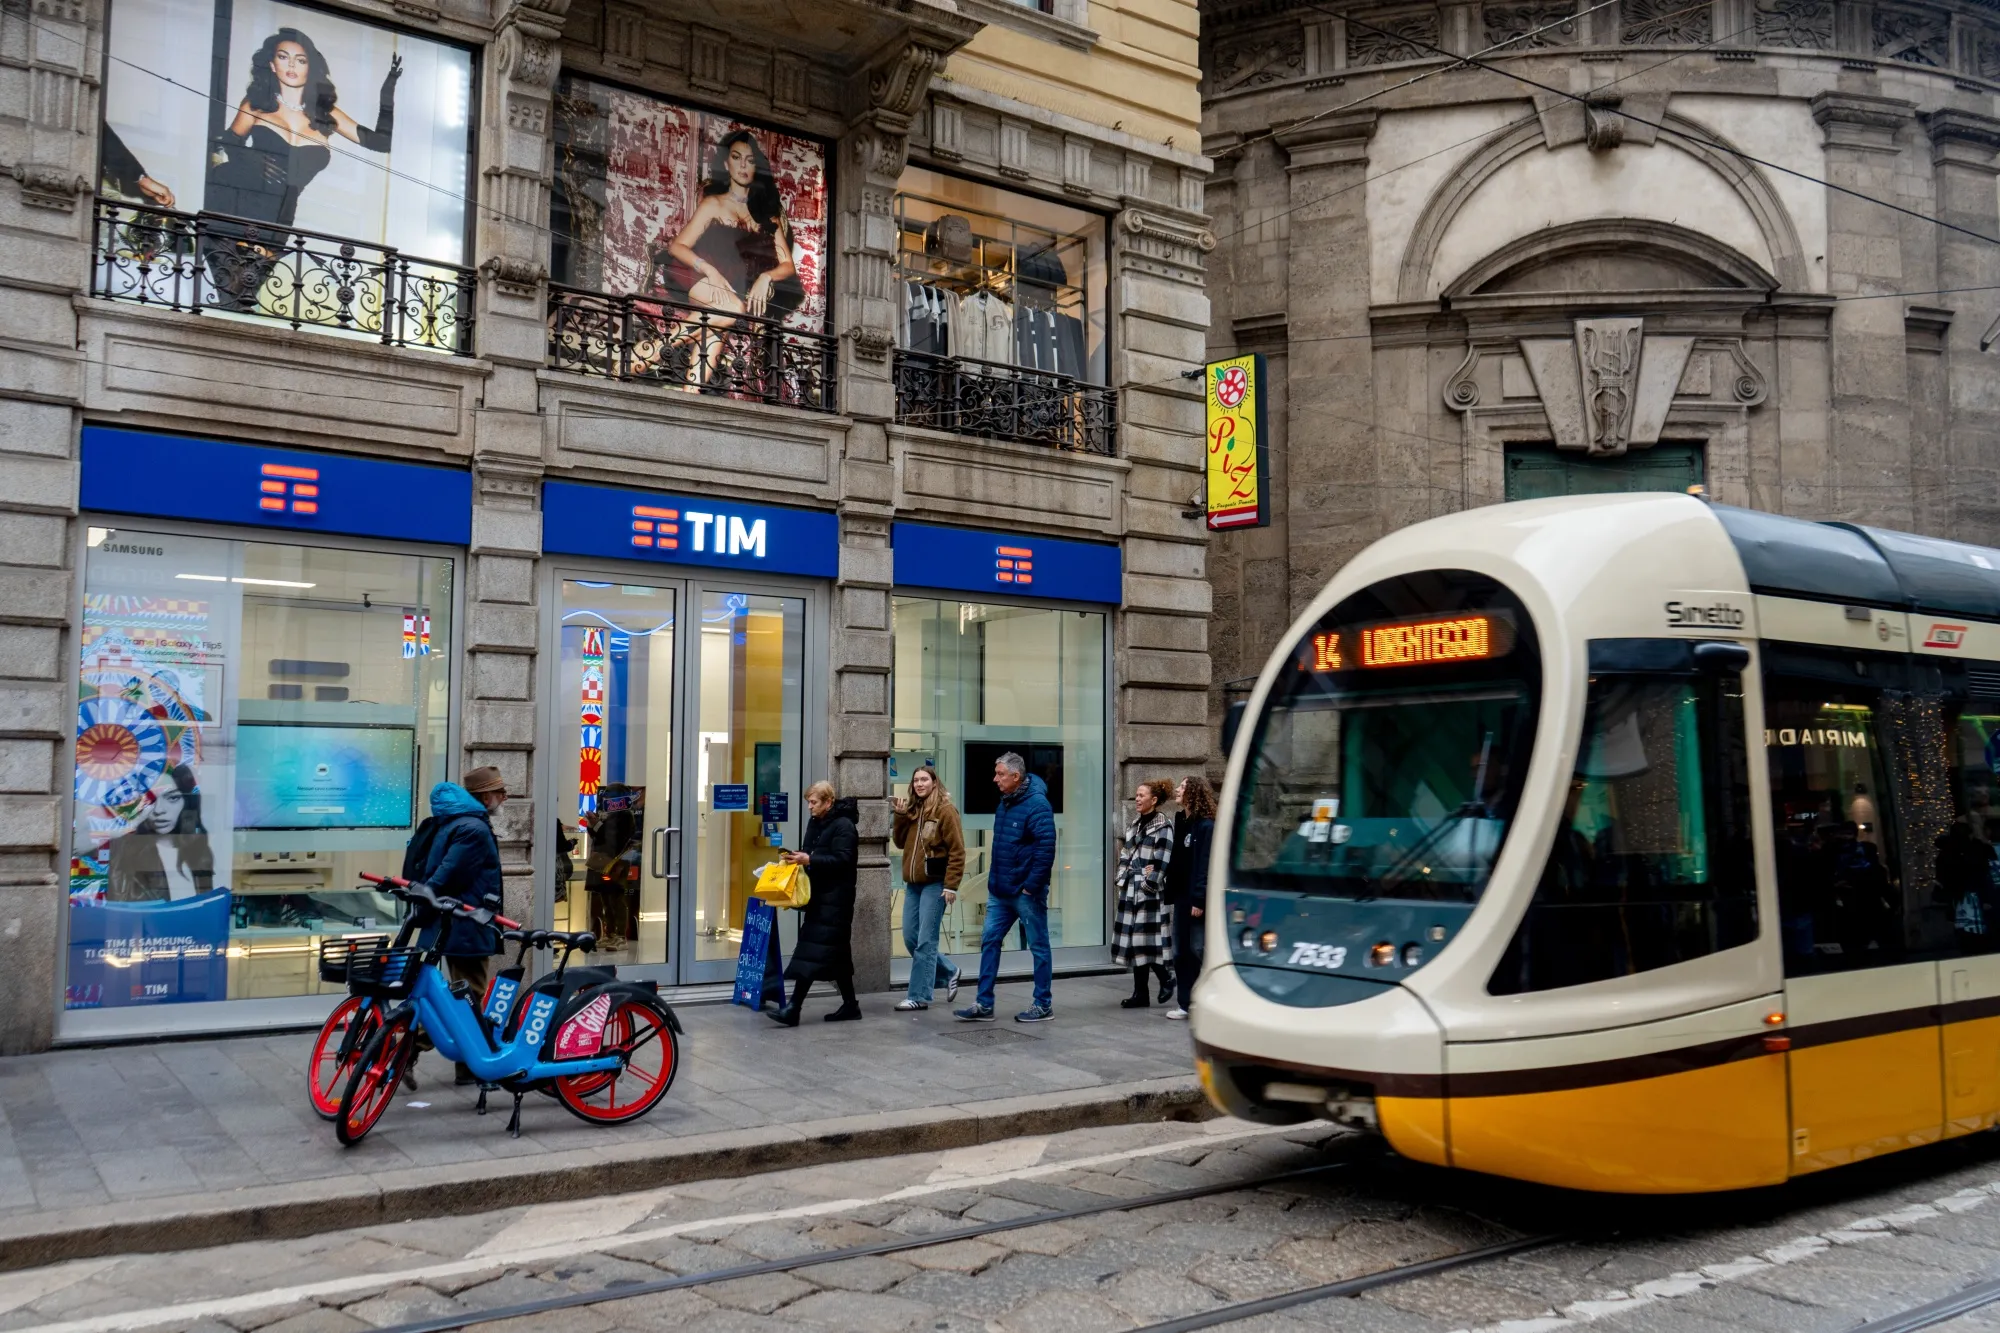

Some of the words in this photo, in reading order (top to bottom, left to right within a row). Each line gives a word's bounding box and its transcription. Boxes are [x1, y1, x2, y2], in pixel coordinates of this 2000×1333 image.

[685, 511, 766, 557] TIM
[103, 543, 164, 556] SAMSUNG
[123, 637, 154, 646] Frame
[160, 639, 192, 649] Galaxy
[202, 641, 222, 651] Flip5
[1315, 634, 1342, 670] 14
[85, 949, 95, 958] TI
[105, 939, 127, 948] TIM
[1287, 941, 1348, 969] 7533
[145, 984, 168, 995] TIM
[489, 982, 516, 1025] dott
[525, 999, 553, 1045] dott
[559, 1022, 578, 1050] PROVA
